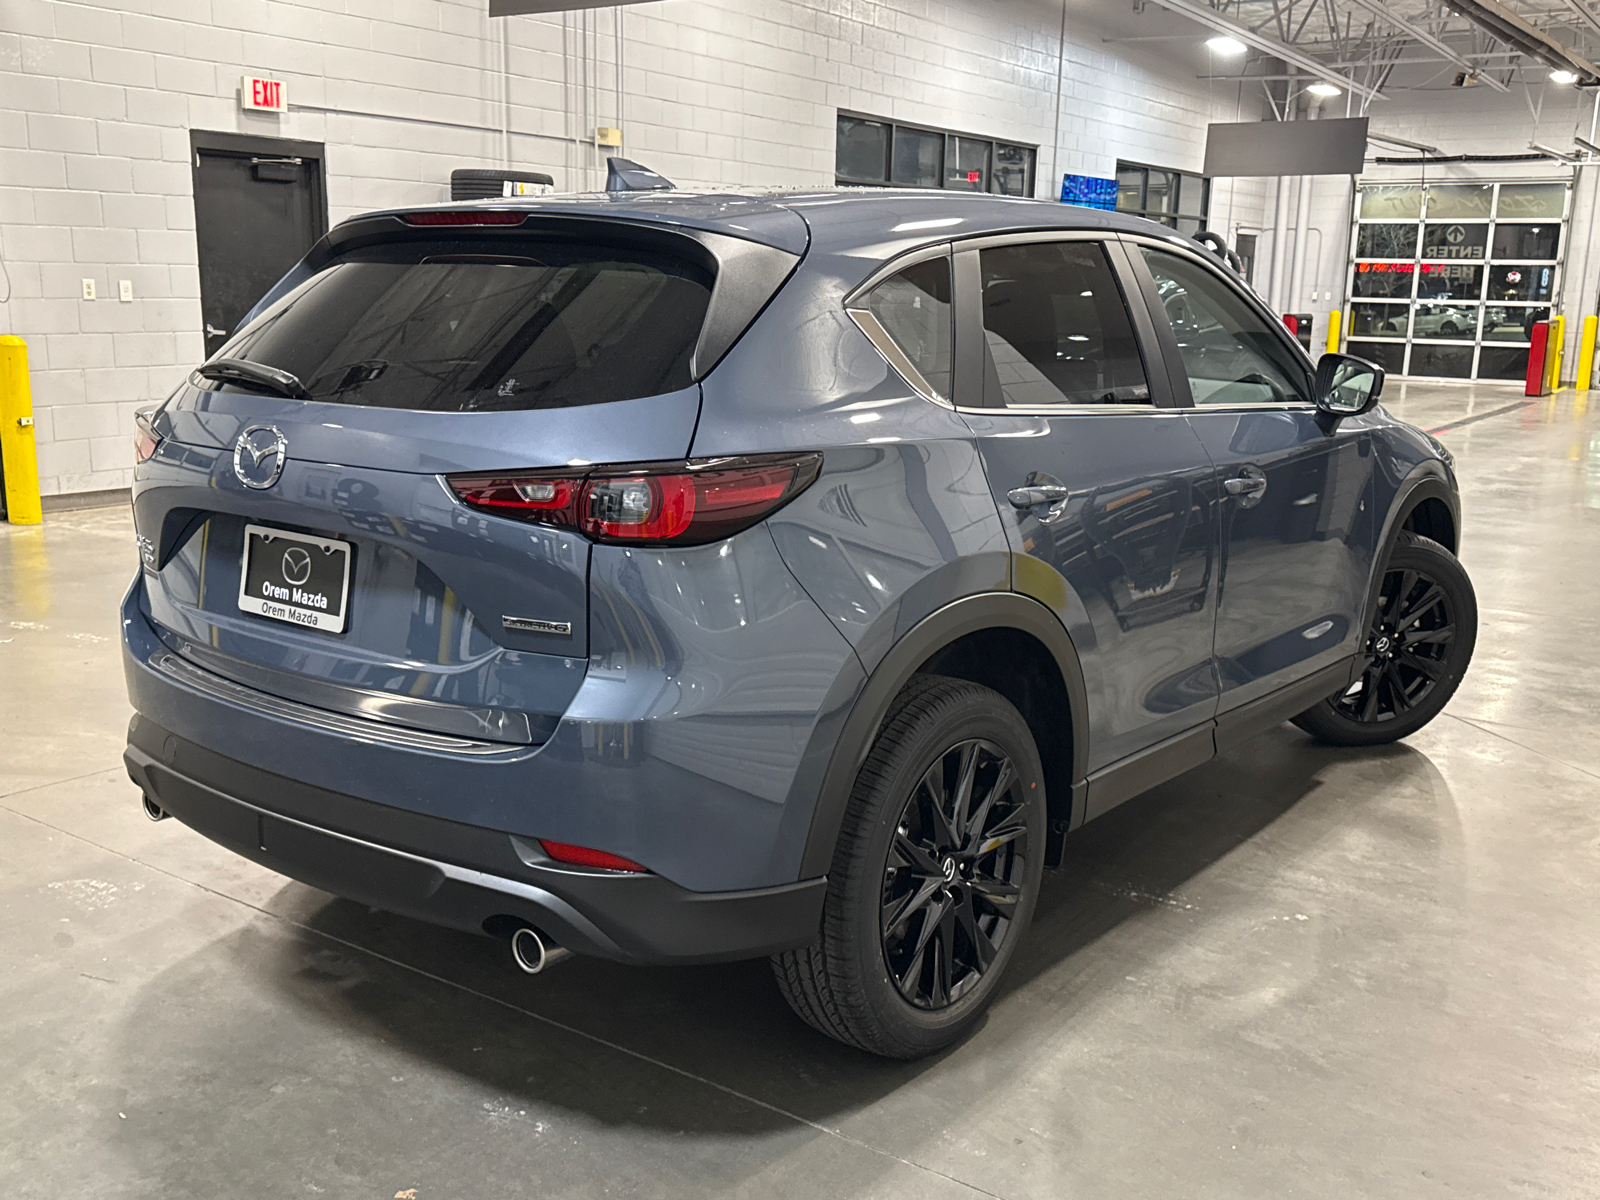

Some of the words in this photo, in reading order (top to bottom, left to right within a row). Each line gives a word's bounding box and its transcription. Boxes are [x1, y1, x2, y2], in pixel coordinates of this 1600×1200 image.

[252, 78, 281, 109] EXIT
[262, 581, 289, 601] Orem
[292, 588, 328, 609] Mazda
[261, 602, 286, 618] Orem
[288, 608, 318, 626] Mazda
